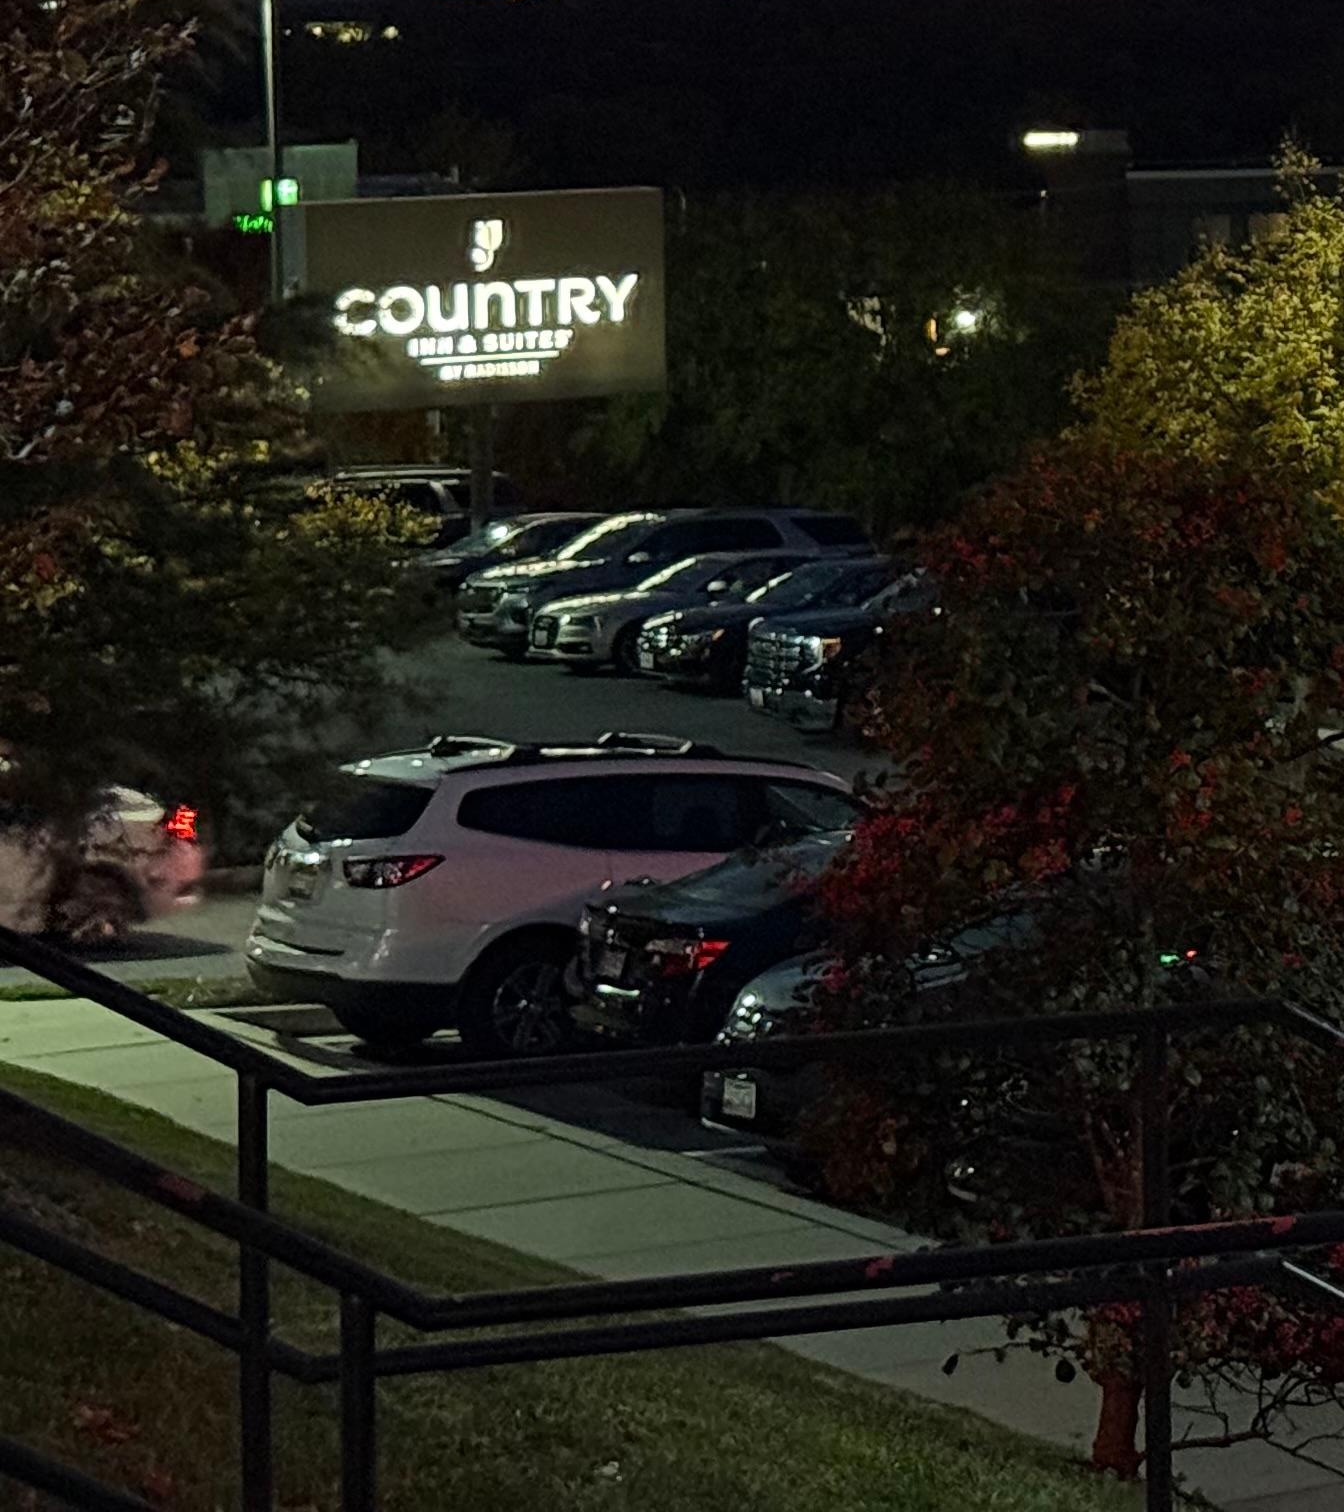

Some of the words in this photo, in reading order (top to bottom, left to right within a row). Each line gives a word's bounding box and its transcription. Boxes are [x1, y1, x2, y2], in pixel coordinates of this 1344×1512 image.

[332, 272, 639, 336] COUNTRY
[407, 337, 454, 357] INN
[457, 334, 477, 354] &
[483, 329, 571, 352] SUITES
[439, 364, 463, 380] BY
